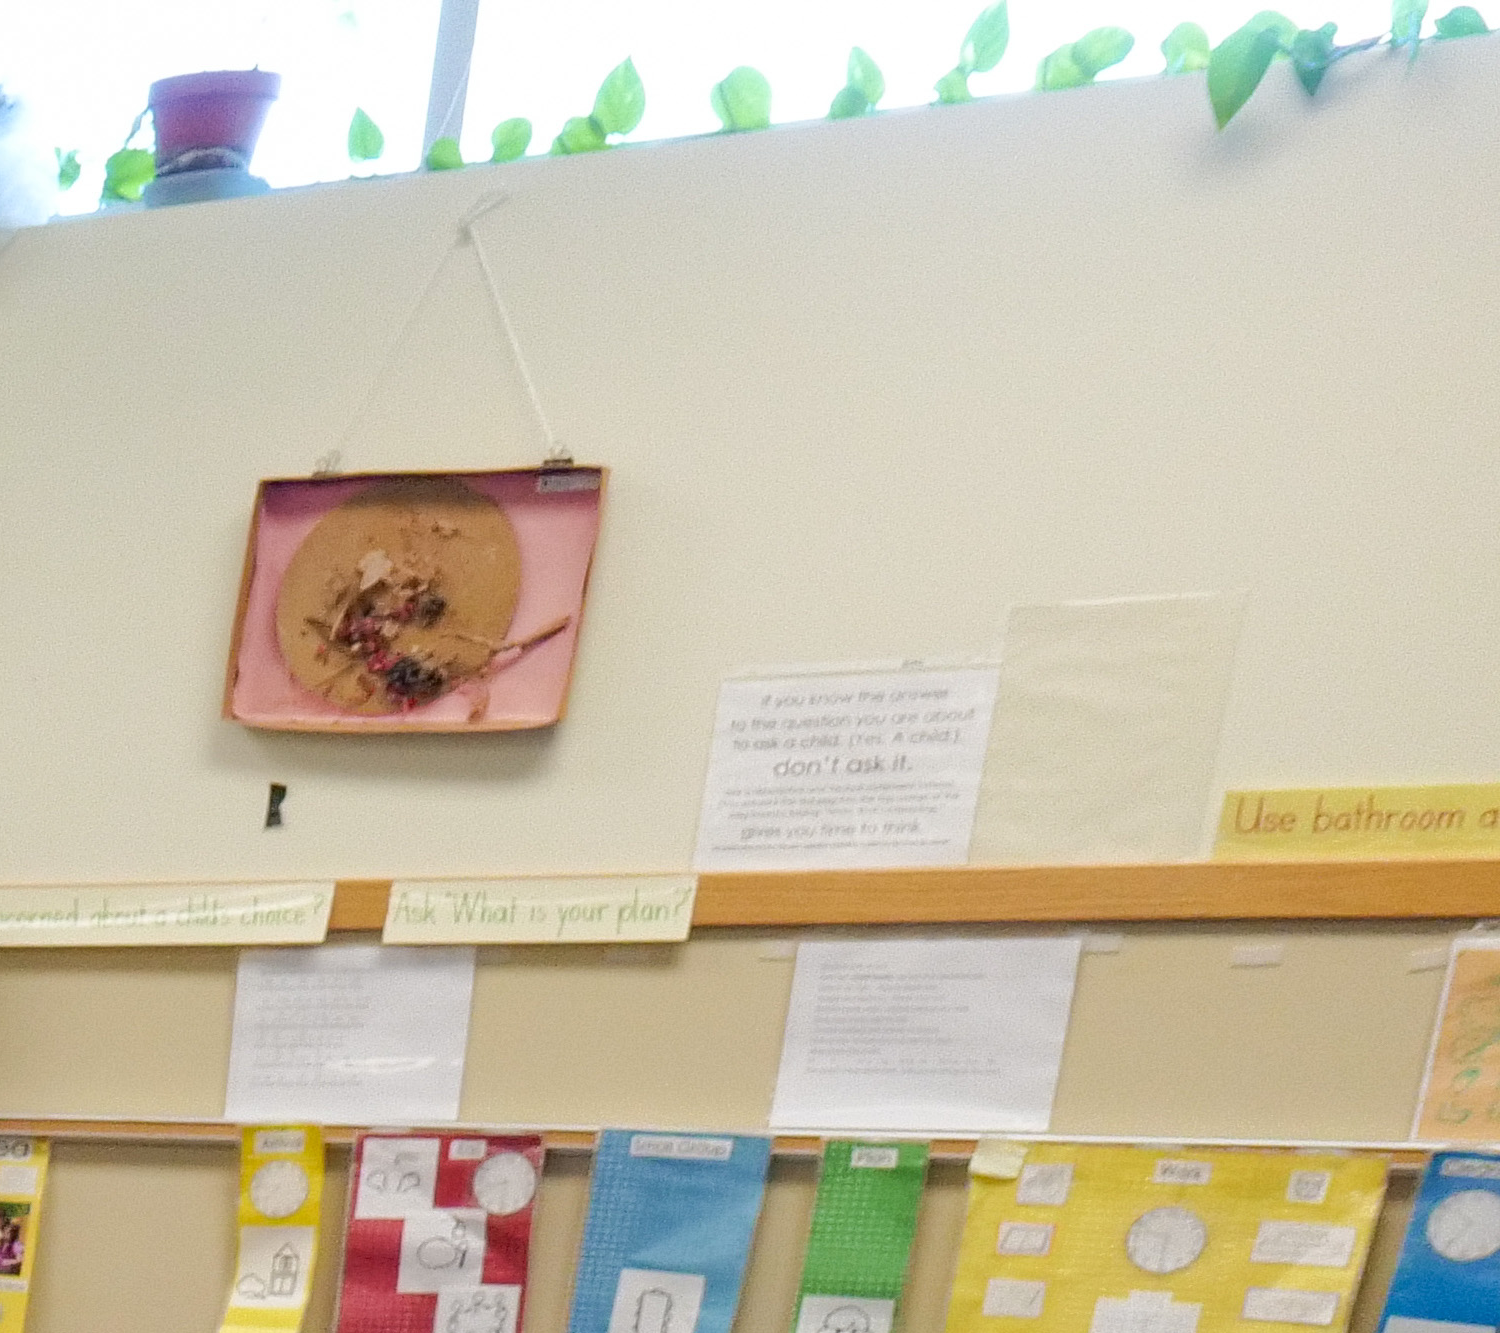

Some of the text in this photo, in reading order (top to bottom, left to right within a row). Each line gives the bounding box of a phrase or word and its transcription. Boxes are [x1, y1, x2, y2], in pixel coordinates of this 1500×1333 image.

[858, 691, 884, 702] the
[731, 708, 975, 732] to the question you are about
[733, 739, 749, 750] to
[753, 737, 778, 749] ask
[783, 739, 795, 749] a
[773, 755, 913, 777] don't ask it.
[1235, 797, 1296, 833] Use
[1312, 793, 1466, 834] bathroom
[394, 891, 436, 925] Ask
[529, 904, 547, 922] is
[557, 904, 607, 937] your
